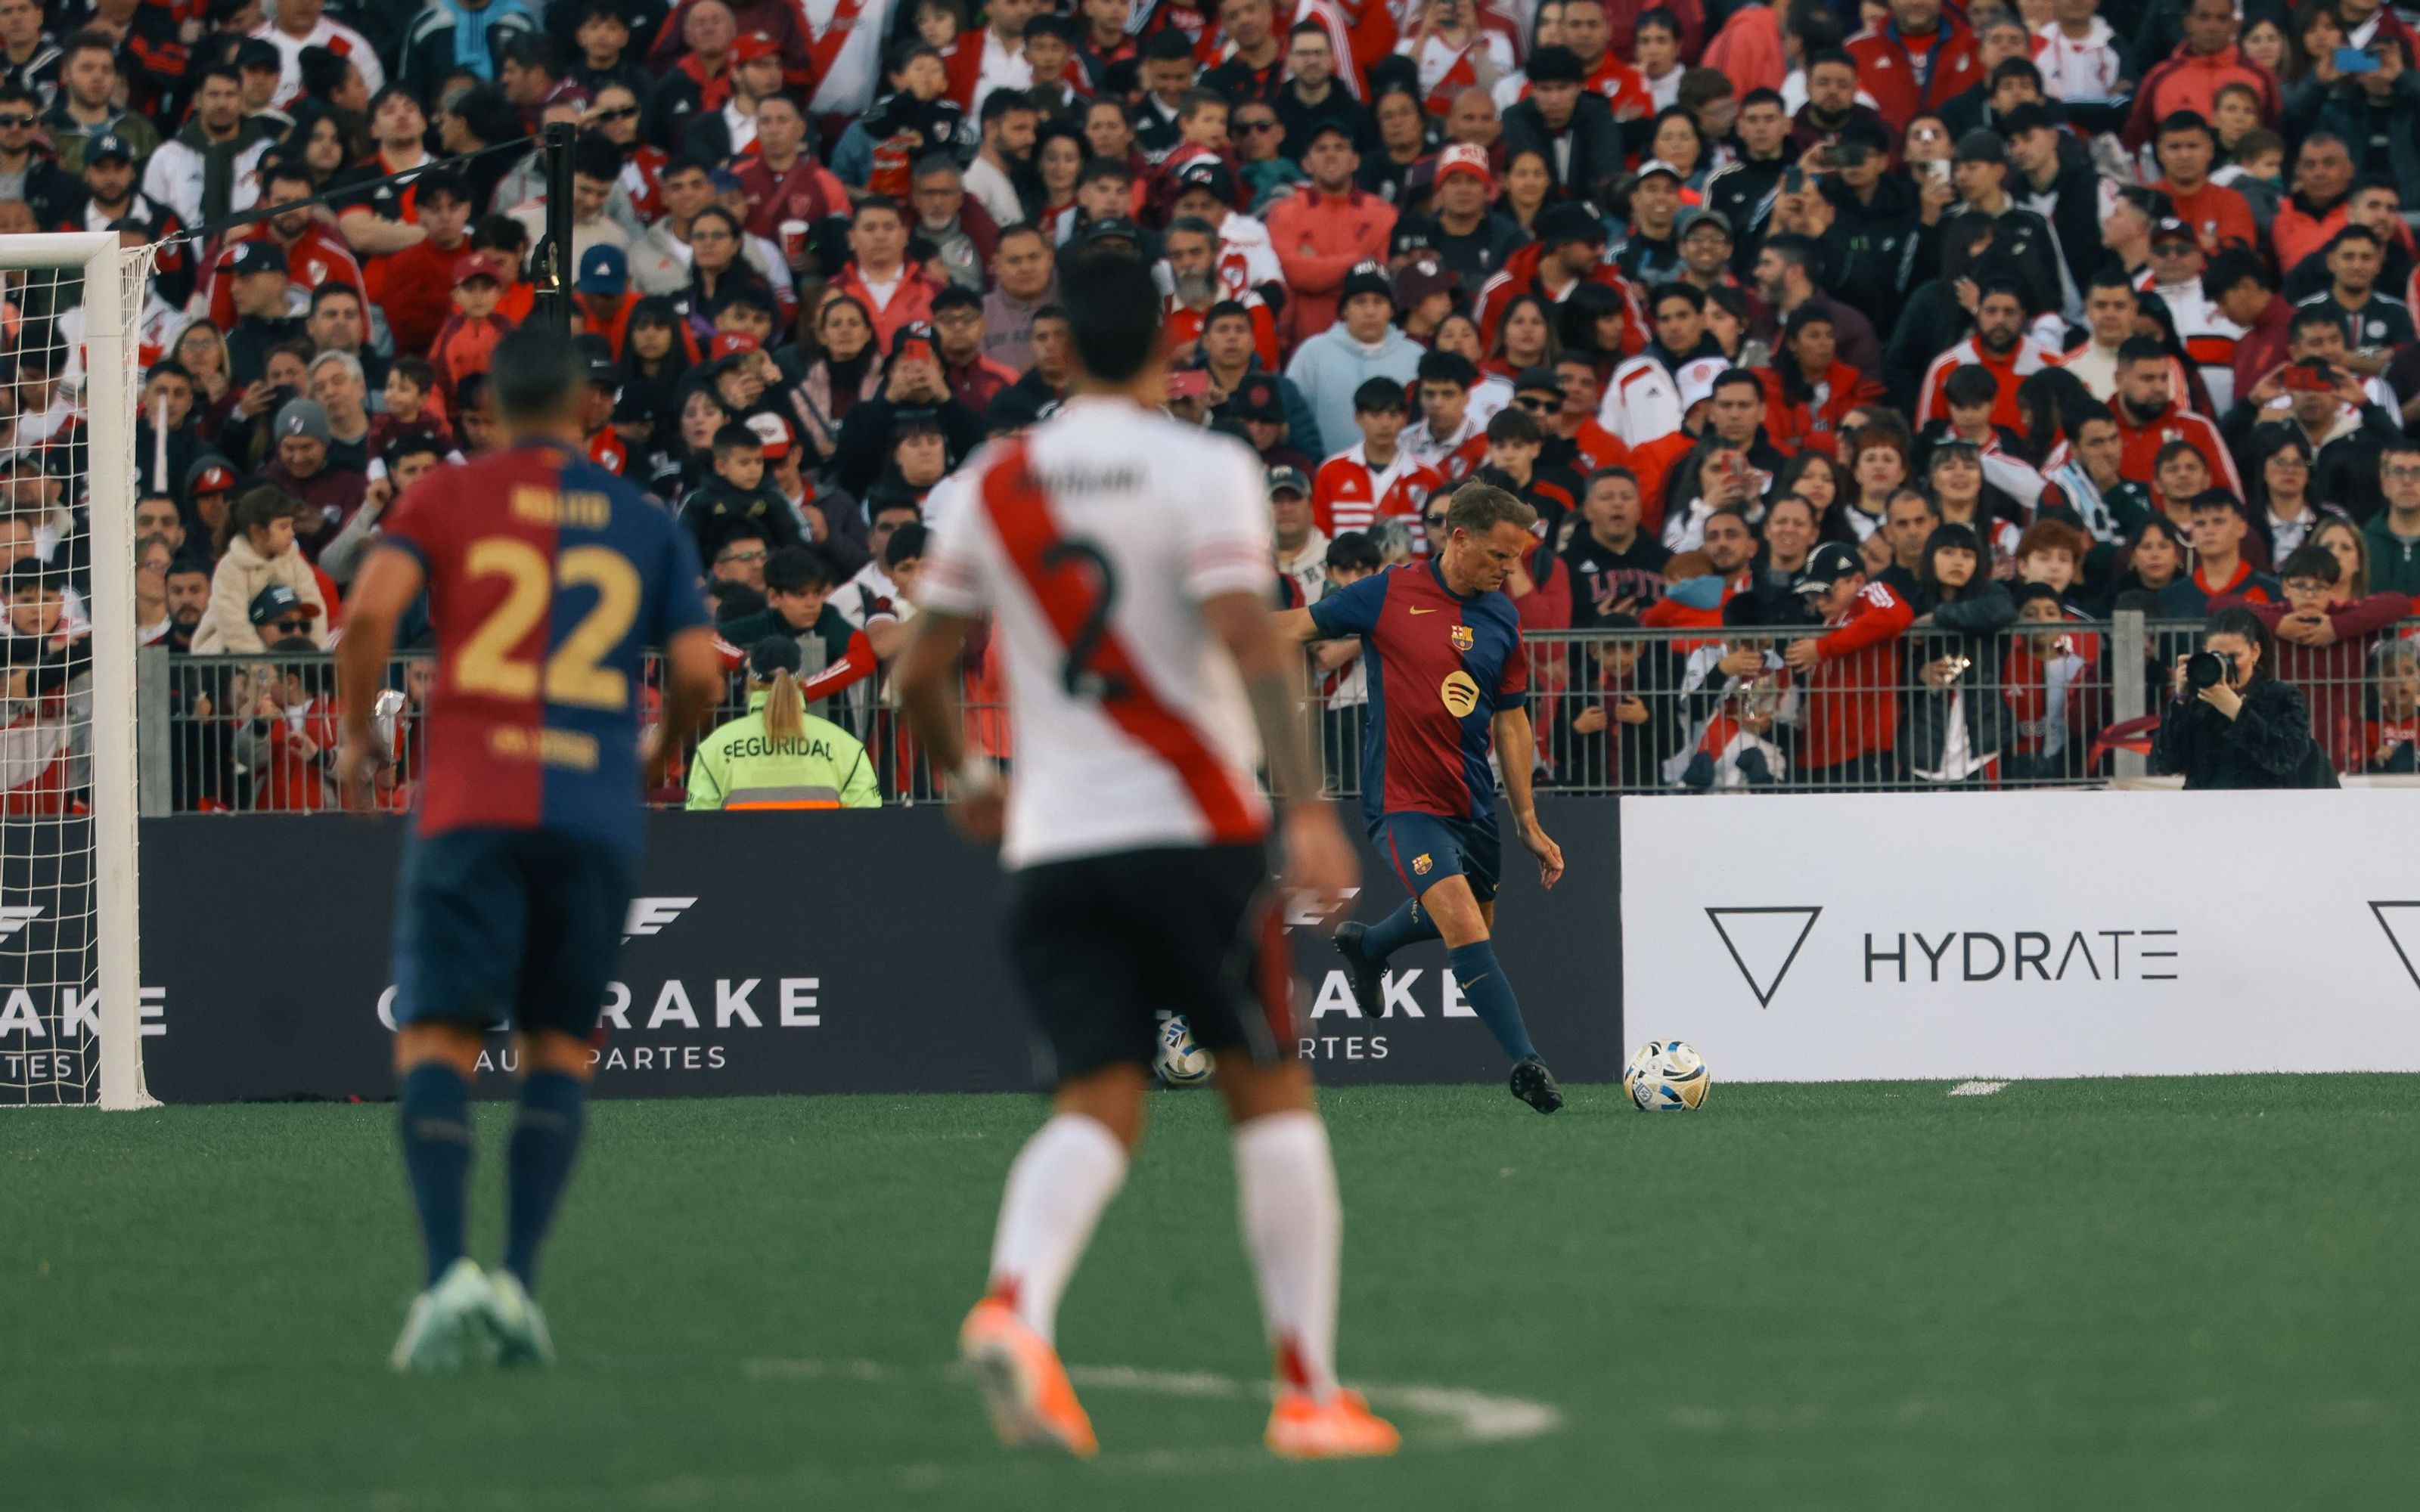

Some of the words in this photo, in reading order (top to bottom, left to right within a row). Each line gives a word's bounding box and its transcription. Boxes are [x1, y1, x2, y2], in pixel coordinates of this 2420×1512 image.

[456, 538, 641, 709] 22
[1041, 540, 1133, 700] 2
[1865, 930, 2178, 982] HYDRATE
